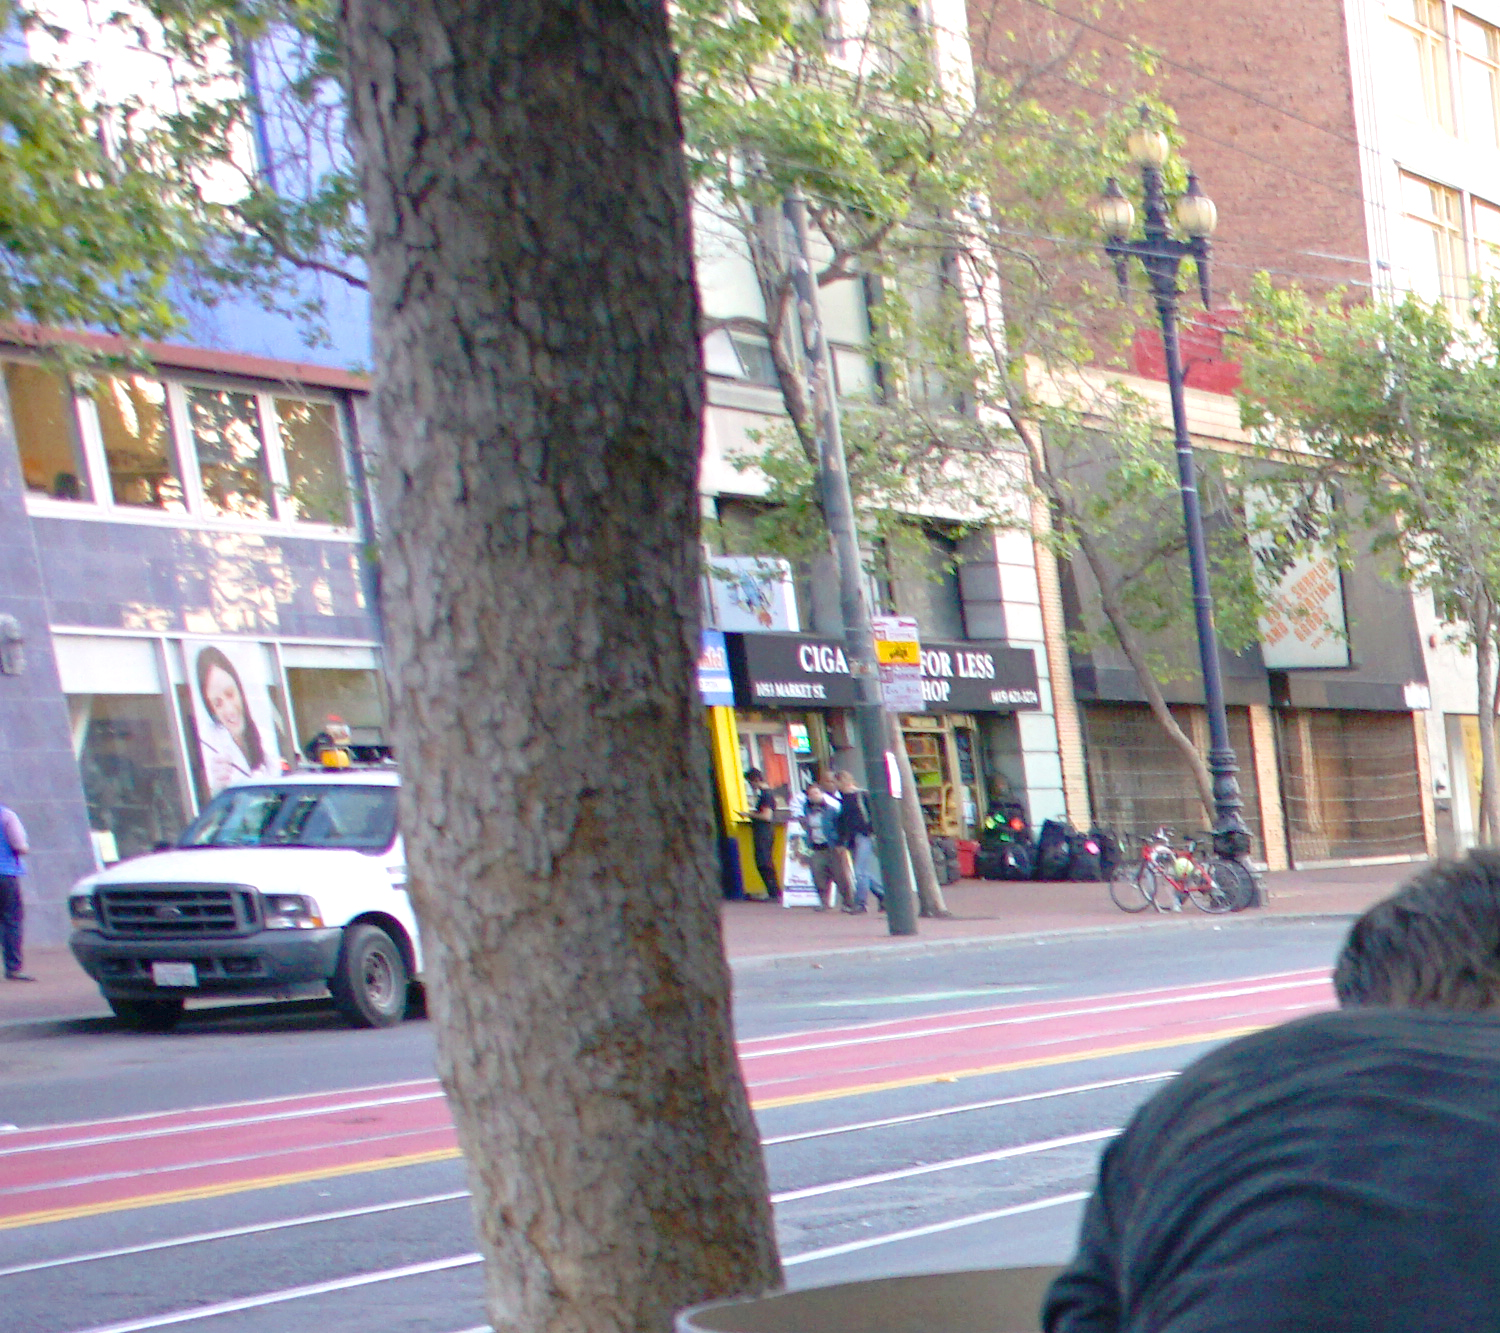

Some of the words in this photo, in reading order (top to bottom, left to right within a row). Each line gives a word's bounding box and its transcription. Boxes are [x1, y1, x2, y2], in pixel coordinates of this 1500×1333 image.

[799, 644, 850, 674] CIGA
[920, 650, 954, 678] FOR
[956, 652, 996, 679] LESS
[920, 680, 951, 702] HOP
